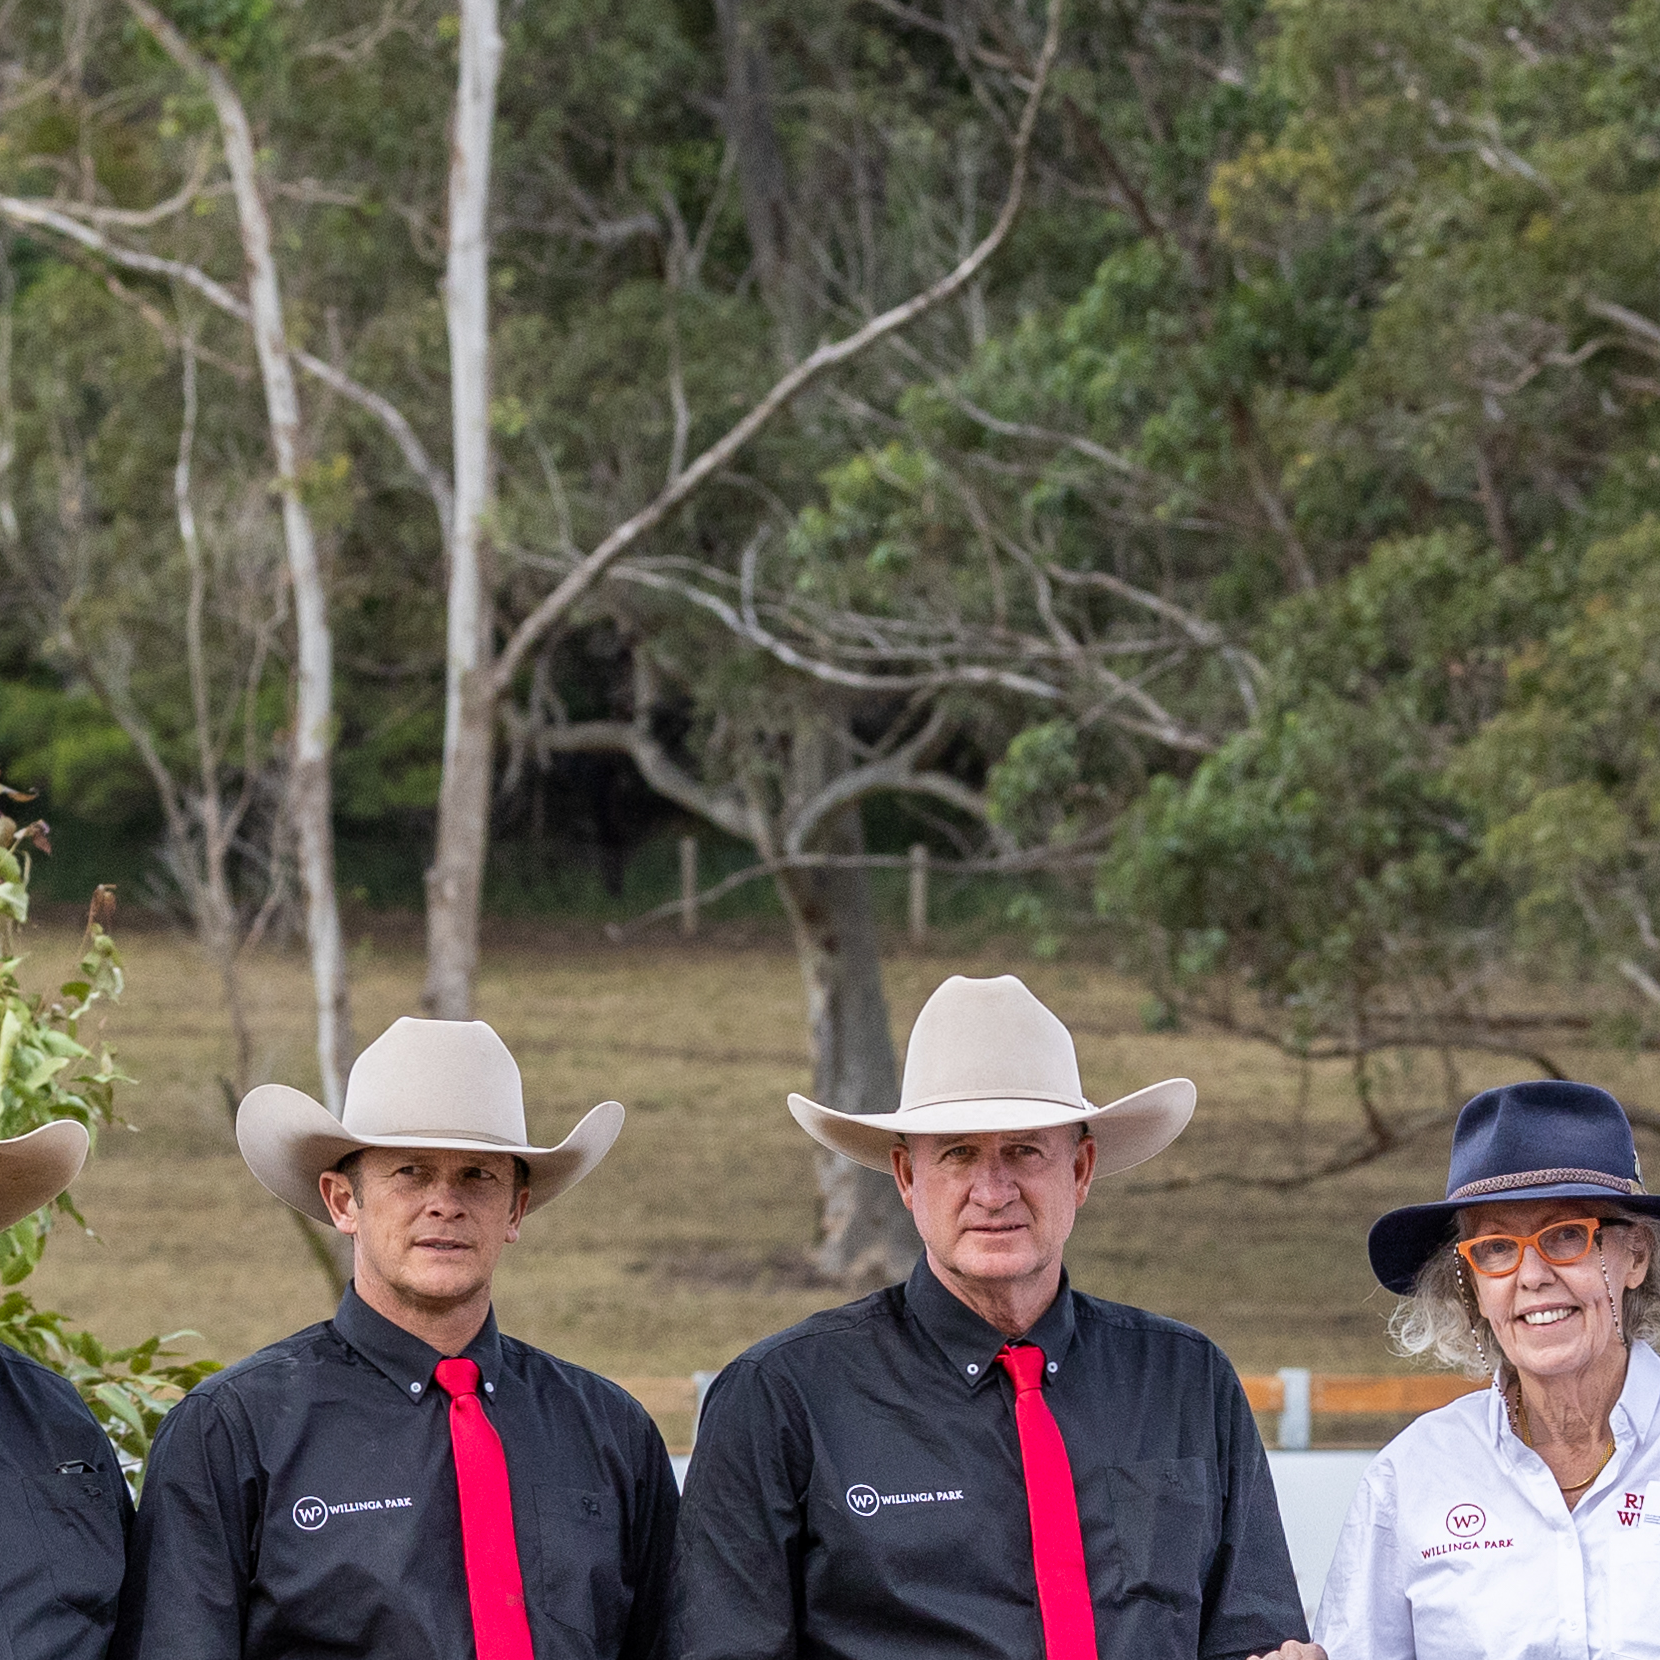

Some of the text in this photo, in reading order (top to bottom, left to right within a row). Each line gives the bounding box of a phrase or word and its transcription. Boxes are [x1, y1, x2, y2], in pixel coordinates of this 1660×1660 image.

[329, 1500, 383, 1515] WILLINGA
[384, 1497, 413, 1509] PARK
[881, 1492, 935, 1505] WILLINGA
[936, 1490, 964, 1501] PARK
[1421, 1538, 1514, 1559] WILLINGA PARK
